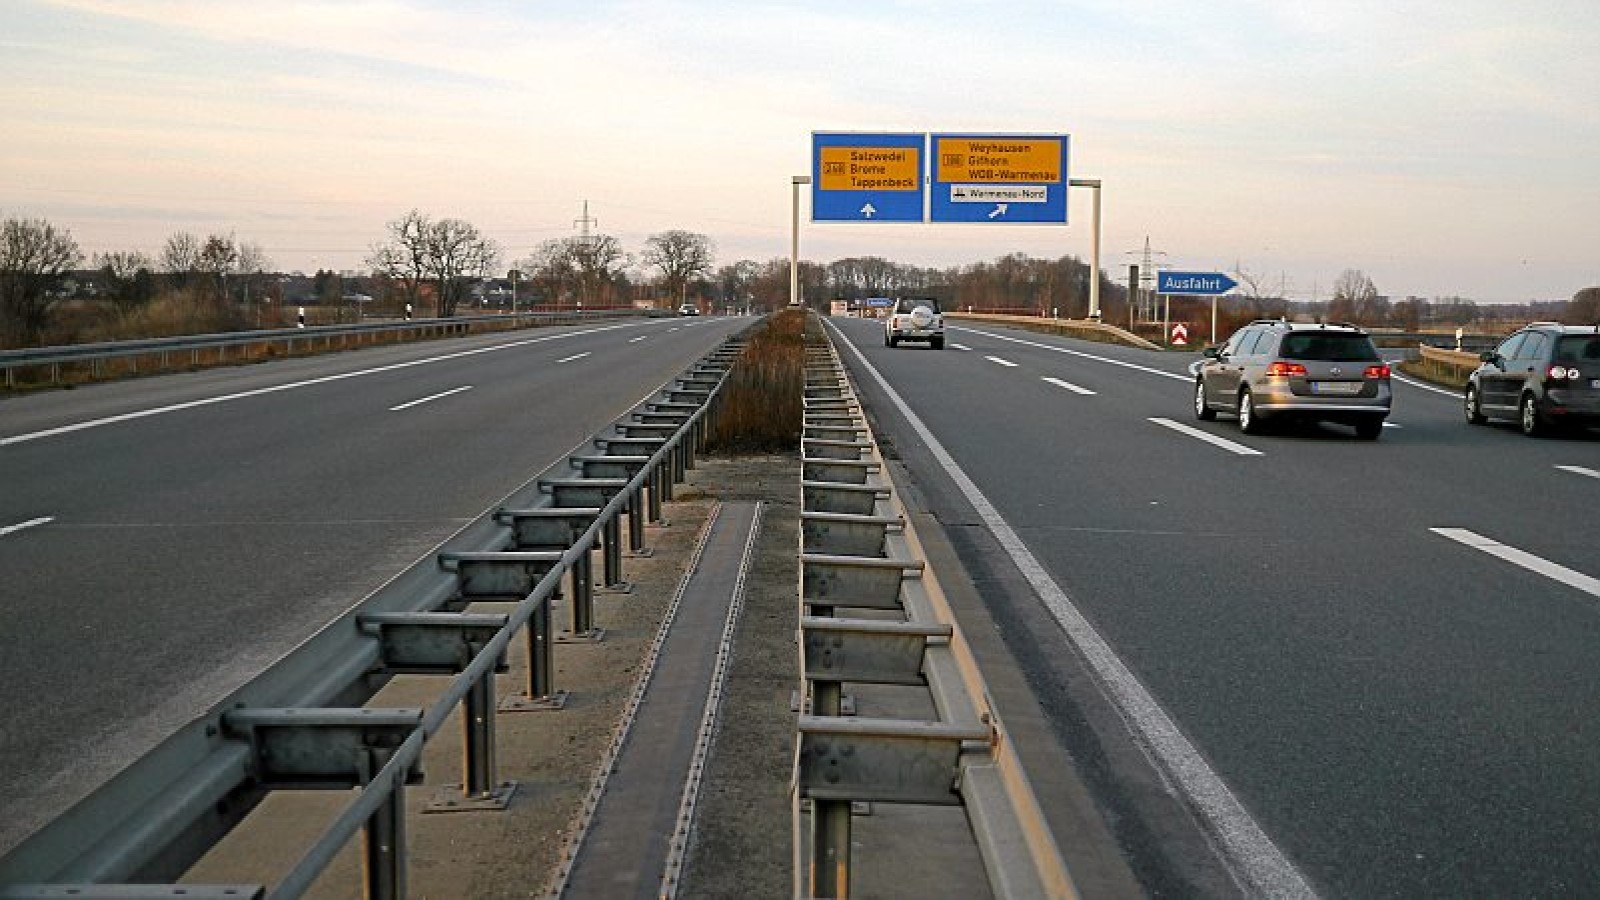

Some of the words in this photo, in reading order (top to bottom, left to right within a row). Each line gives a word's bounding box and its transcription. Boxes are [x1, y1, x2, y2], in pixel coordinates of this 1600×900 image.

[850, 151, 906, 162] Salzwedel
[850, 163, 886, 175] Brome
[851, 177, 914, 188] Tappenbeck
[1164, 276, 1221, 290] Ausfahrt
